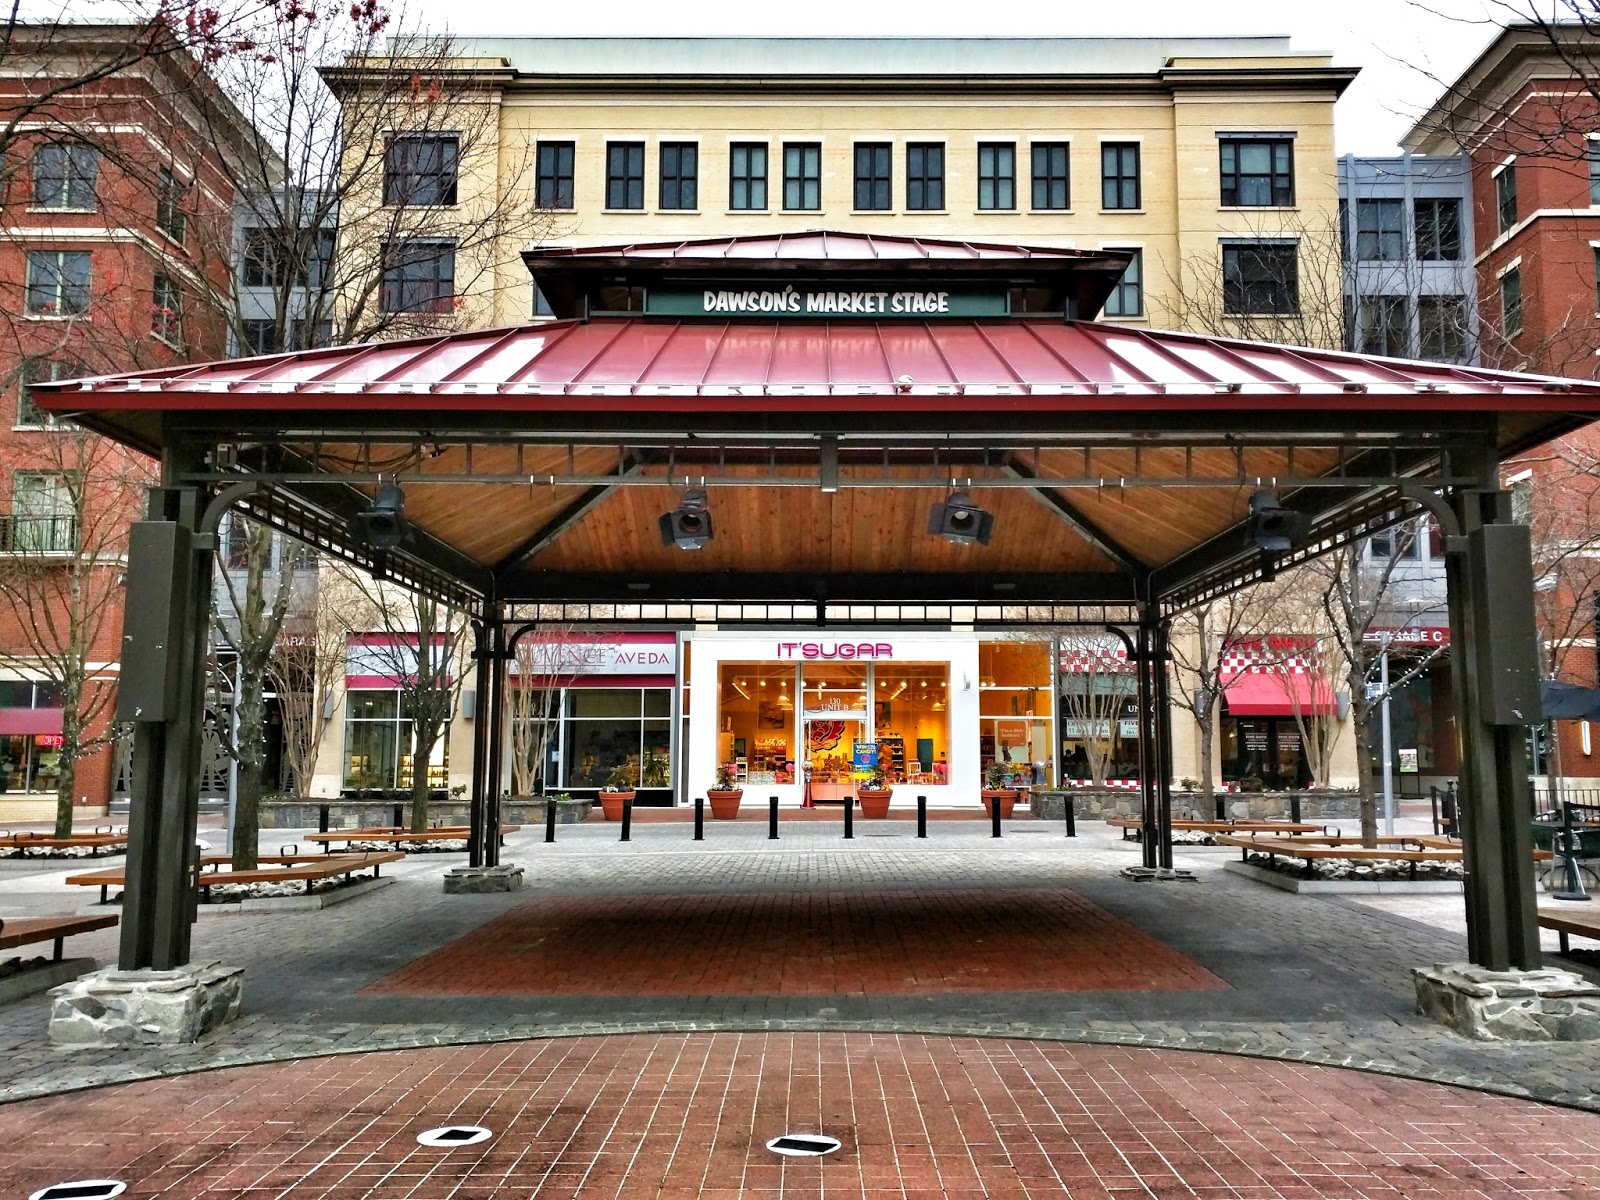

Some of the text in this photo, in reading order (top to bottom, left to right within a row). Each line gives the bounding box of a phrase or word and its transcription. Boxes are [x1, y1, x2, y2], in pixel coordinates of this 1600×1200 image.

[703, 287, 949, 313] DAWSON'S MARKET STAGE
[615, 652, 670, 664] AVEDA
